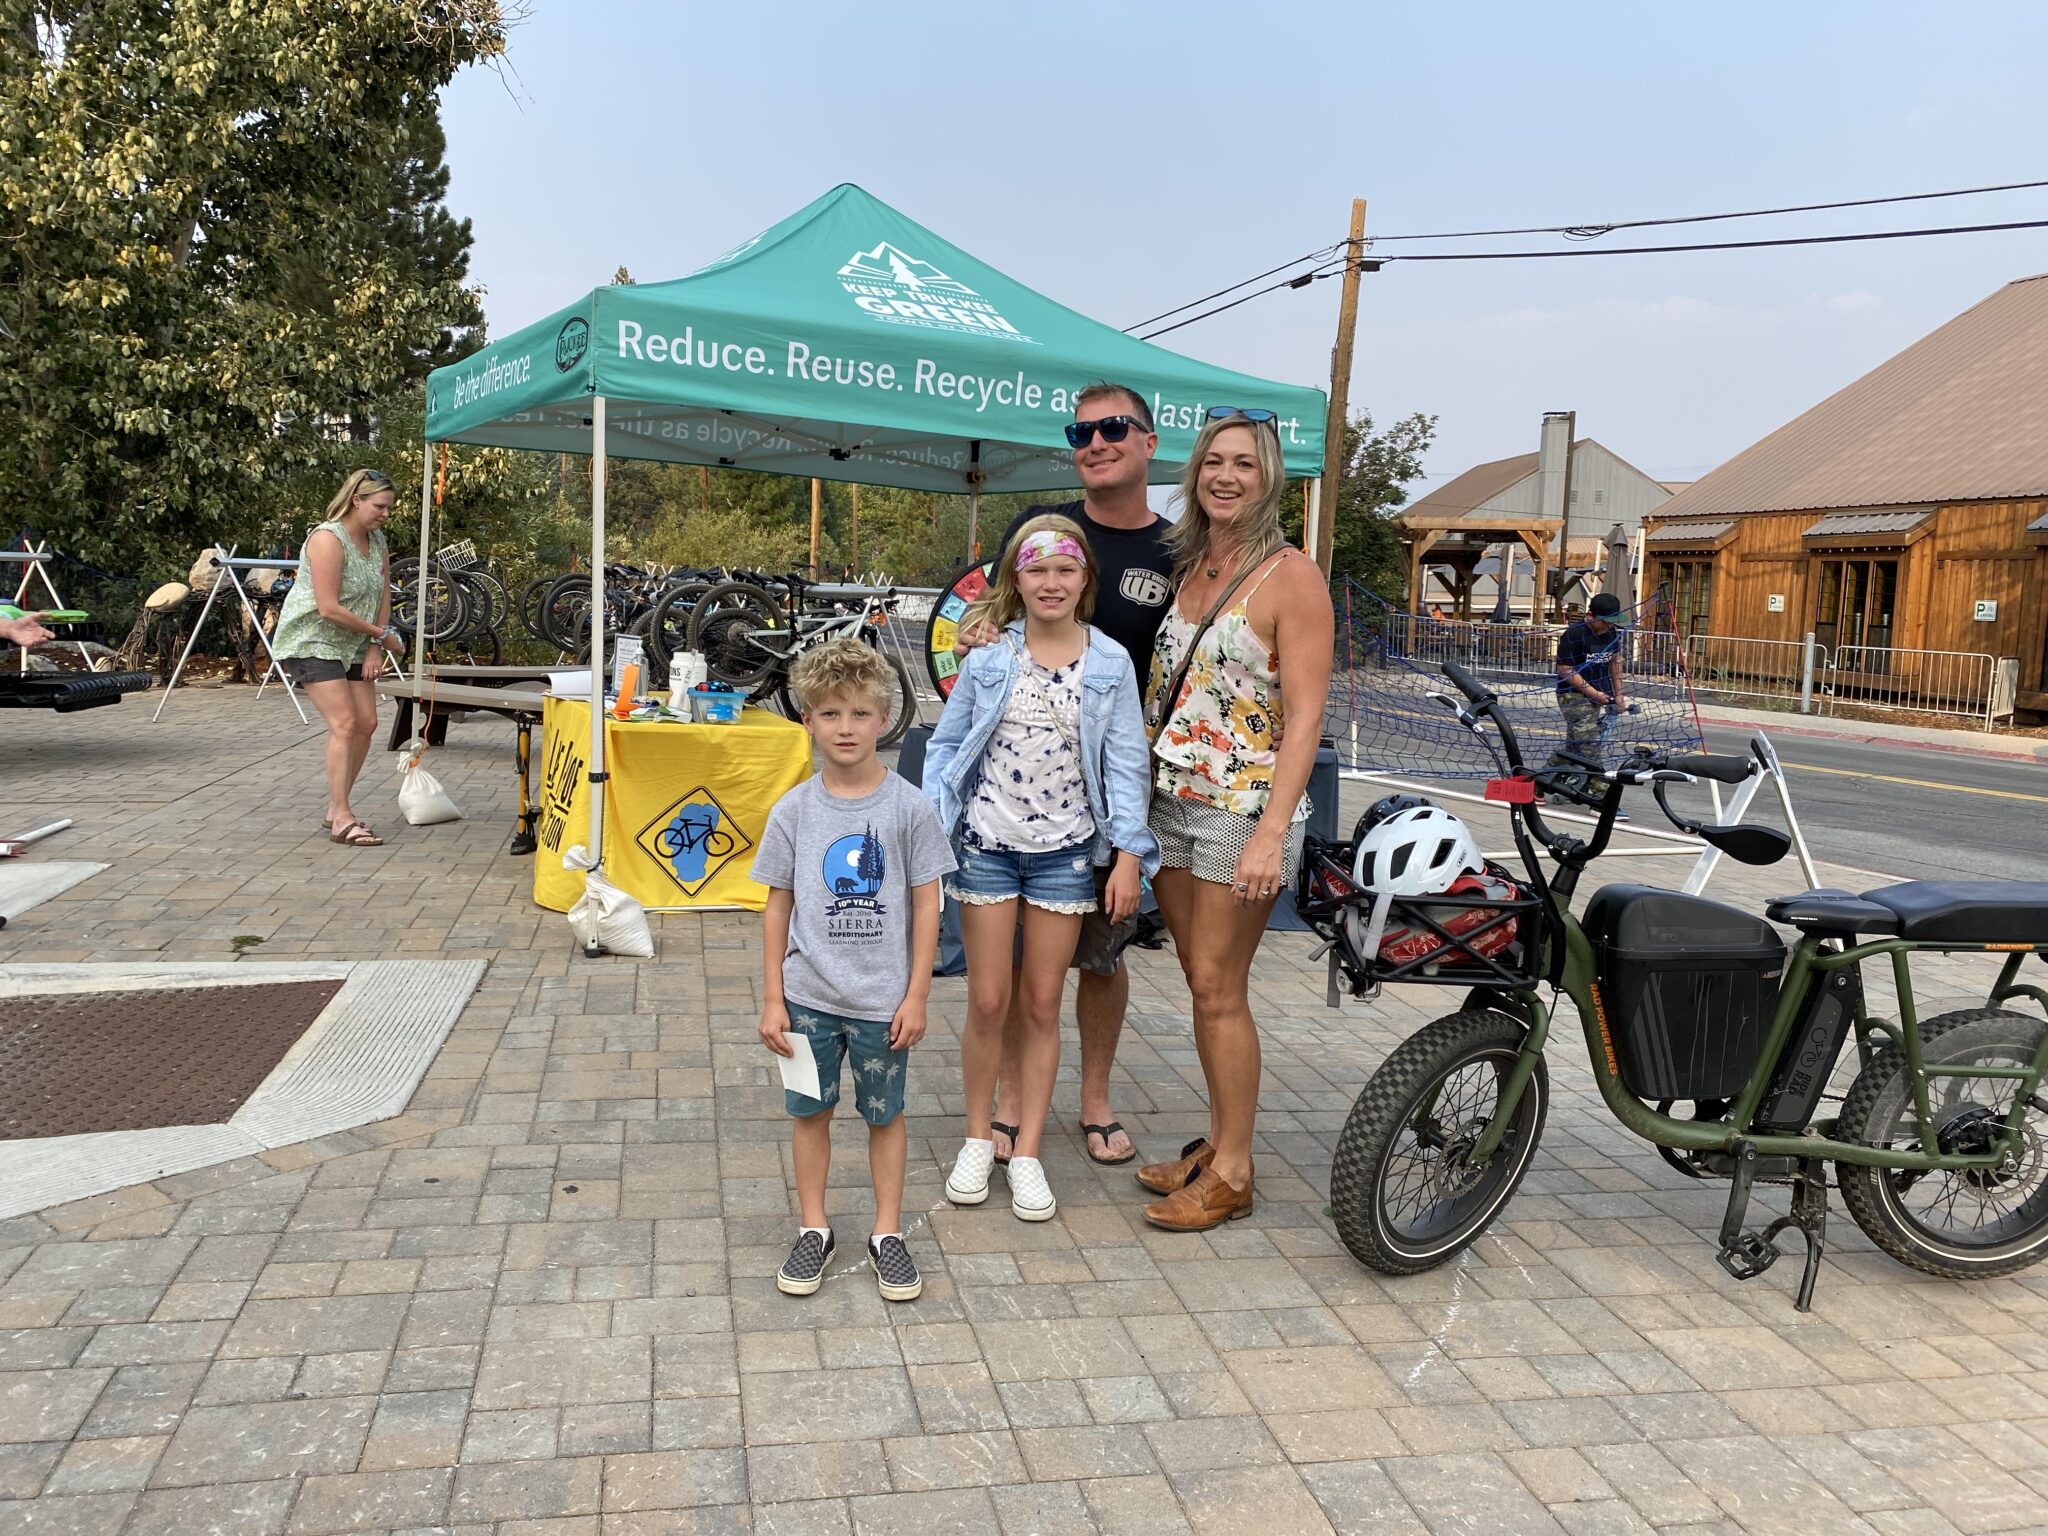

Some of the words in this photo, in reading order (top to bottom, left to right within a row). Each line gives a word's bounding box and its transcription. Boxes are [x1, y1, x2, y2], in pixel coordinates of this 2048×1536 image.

[841, 282, 897, 298] KEEP
[903, 291, 999, 314] TRUCKEE
[854, 296, 1021, 334] GREEN
[453, 376, 465, 410] Be
[465, 368, 480, 404] the
[480, 354, 531, 398] difference.
[617, 320, 775, 376] Reduce.
[786, 341, 904, 392] Reuse.
[914, 358, 1042, 413] Recycle
[1152, 392, 1204, 432] last
[1128, 571, 1151, 579] WATER
[853, 899, 875, 908] YEAR
[828, 919, 883, 929] SIERRA
[828, 930, 884, 938] EXPEDITIONARY
[1589, 983, 1602, 1006] RAD
[1595, 1007, 1612, 1045] POWER
[1604, 1046, 1619, 1076] BIKES
[1789, 1069, 1802, 1095] RAD
[1797, 1073, 1812, 1098] RIDE
